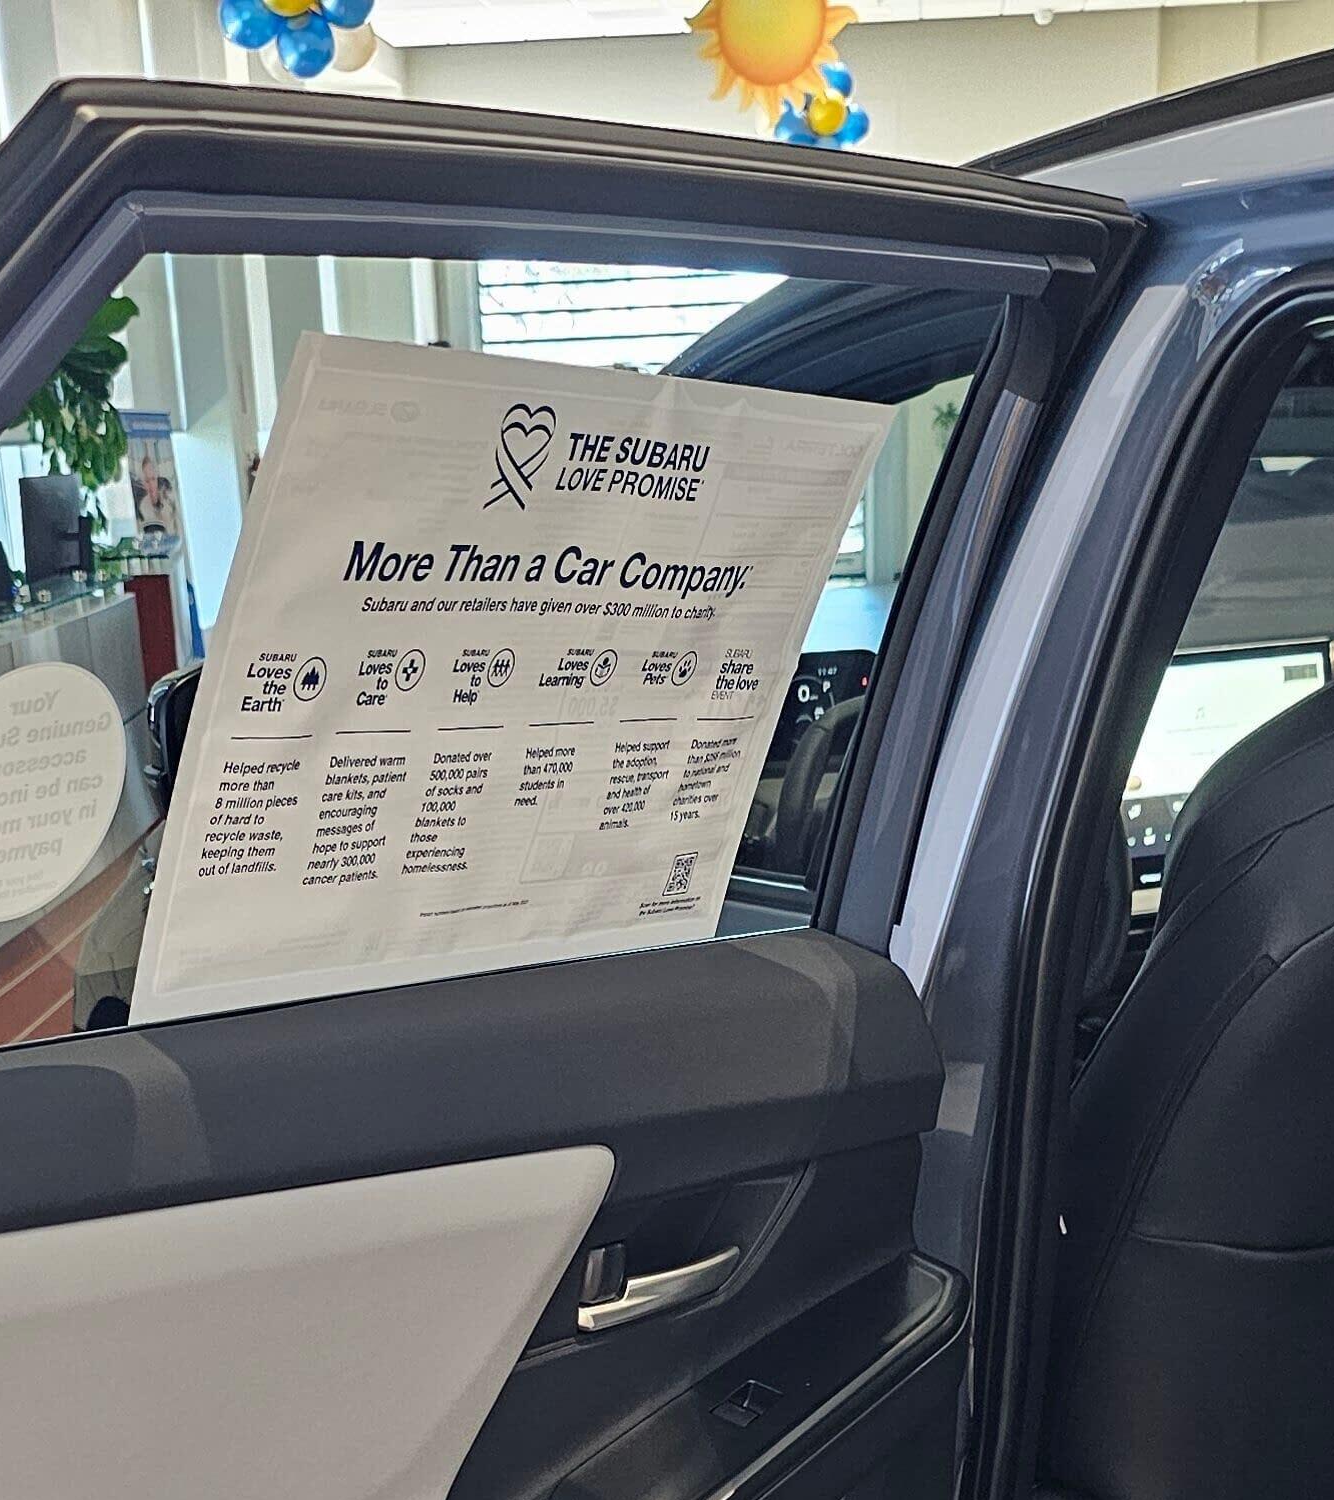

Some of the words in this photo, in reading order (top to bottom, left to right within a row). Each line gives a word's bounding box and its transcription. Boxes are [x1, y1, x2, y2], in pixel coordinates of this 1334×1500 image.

[567, 432, 612, 464] THE
[614, 436, 710, 472] SUBARU
[555, 467, 604, 494] LOVE
[607, 472, 702, 502] PROMISE
[343, 541, 434, 583] More
[443, 543, 520, 583] Than
[525, 555, 547, 583] a
[554, 545, 616, 587] Car
[619, 552, 750, 600] Company.
[361, 596, 409, 612] Subaru
[410, 597, 437, 612] and
[437, 600, 459, 612] our
[459, 597, 507, 612] retailers
[509, 597, 538, 612] have
[539, 598, 572, 615] given
[574, 602, 602, 615] over
[603, 601, 632, 617] $300
[632, 603, 670, 618] million
[670, 605, 683, 618] to
[258, 652, 298, 663] SUBARU
[366, 648, 398, 658] SUBARU
[461, 648, 491, 657] SUBARU
[566, 648, 596, 657] SUBARU
[651, 650, 679, 659] SUBARU
[246, 662, 293, 679] Loves
[358, 660, 393, 677] Loves
[452, 659, 486, 673] Loves
[557, 657, 589, 671] Loves
[641, 659, 673, 674] Loves
[719, 659, 754, 675] share
[375, 677, 389, 691] to
[470, 673, 482, 688] to
[538, 673, 585, 689] Learning
[643, 673, 667, 686] Pets
[715, 675, 735, 690] the
[735, 675, 759, 691] love
[262, 680, 287, 695] the
[241, 697, 283, 712] Earth
[356, 691, 387, 706] Care
[452, 689, 479, 706] Help
[525, 746, 555, 761] Helped
[555, 747, 576, 757] more
[614, 741, 642, 755] Helped
[642, 739, 671, 754] support
[329, 755, 378, 768] Delivered
[379, 756, 406, 766] warm
[433, 751, 472, 764] Donated
[473, 752, 493, 762] over
[612, 758, 625, 769] the
[223, 761, 265, 777] Helped
[266, 759, 301, 775] recycle
[429, 768, 465, 782] 500,000
[465, 767, 488, 782] pairs
[523, 763, 542, 776] than
[218, 781, 250, 791] more
[252, 779, 275, 791] than
[325, 772, 370, 786] blankets,
[371, 771, 407, 786] patient
[518, 779, 556, 791] students
[556, 777, 565, 789] in
[321, 791, 343, 802] care
[344, 789, 365, 801] kits,
[367, 787, 388, 799] and
[425, 785, 437, 797] of
[437, 785, 464, 797] socks
[465, 783, 484, 795] and
[606, 788, 622, 800] and
[621, 786, 643, 799] health
[642, 784, 652, 795] of
[214, 797, 223, 809] 8
[225, 797, 264, 809] million
[265, 795, 299, 811] pieces
[421, 800, 456, 813] 100,000
[603, 805, 621, 815] over
[209, 814, 224, 825] of
[223, 813, 252, 825] hard
[253, 814, 265, 825] to
[318, 804, 378, 820] encouraging
[670, 810, 679, 822] 15
[316, 822, 363, 838] messages
[364, 819, 376, 832] of
[414, 817, 456, 828] blankets
[457, 816, 467, 827] to
[204, 830, 246, 844] recycle
[248, 830, 284, 842] waste,
[409, 832, 438, 843] those
[312, 842, 337, 855] hope
[339, 841, 349, 851] to
[351, 835, 386, 851] support
[201, 846, 245, 861] keeping
[247, 846, 276, 857] them
[406, 846, 466, 861] experiencing
[307, 857, 340, 871] nearly
[340, 852, 376, 868] 300,000
[198, 865, 216, 878] out
[218, 862, 231, 876] of
[230, 861, 277, 875] landfills.
[302, 875, 338, 886] cancer
